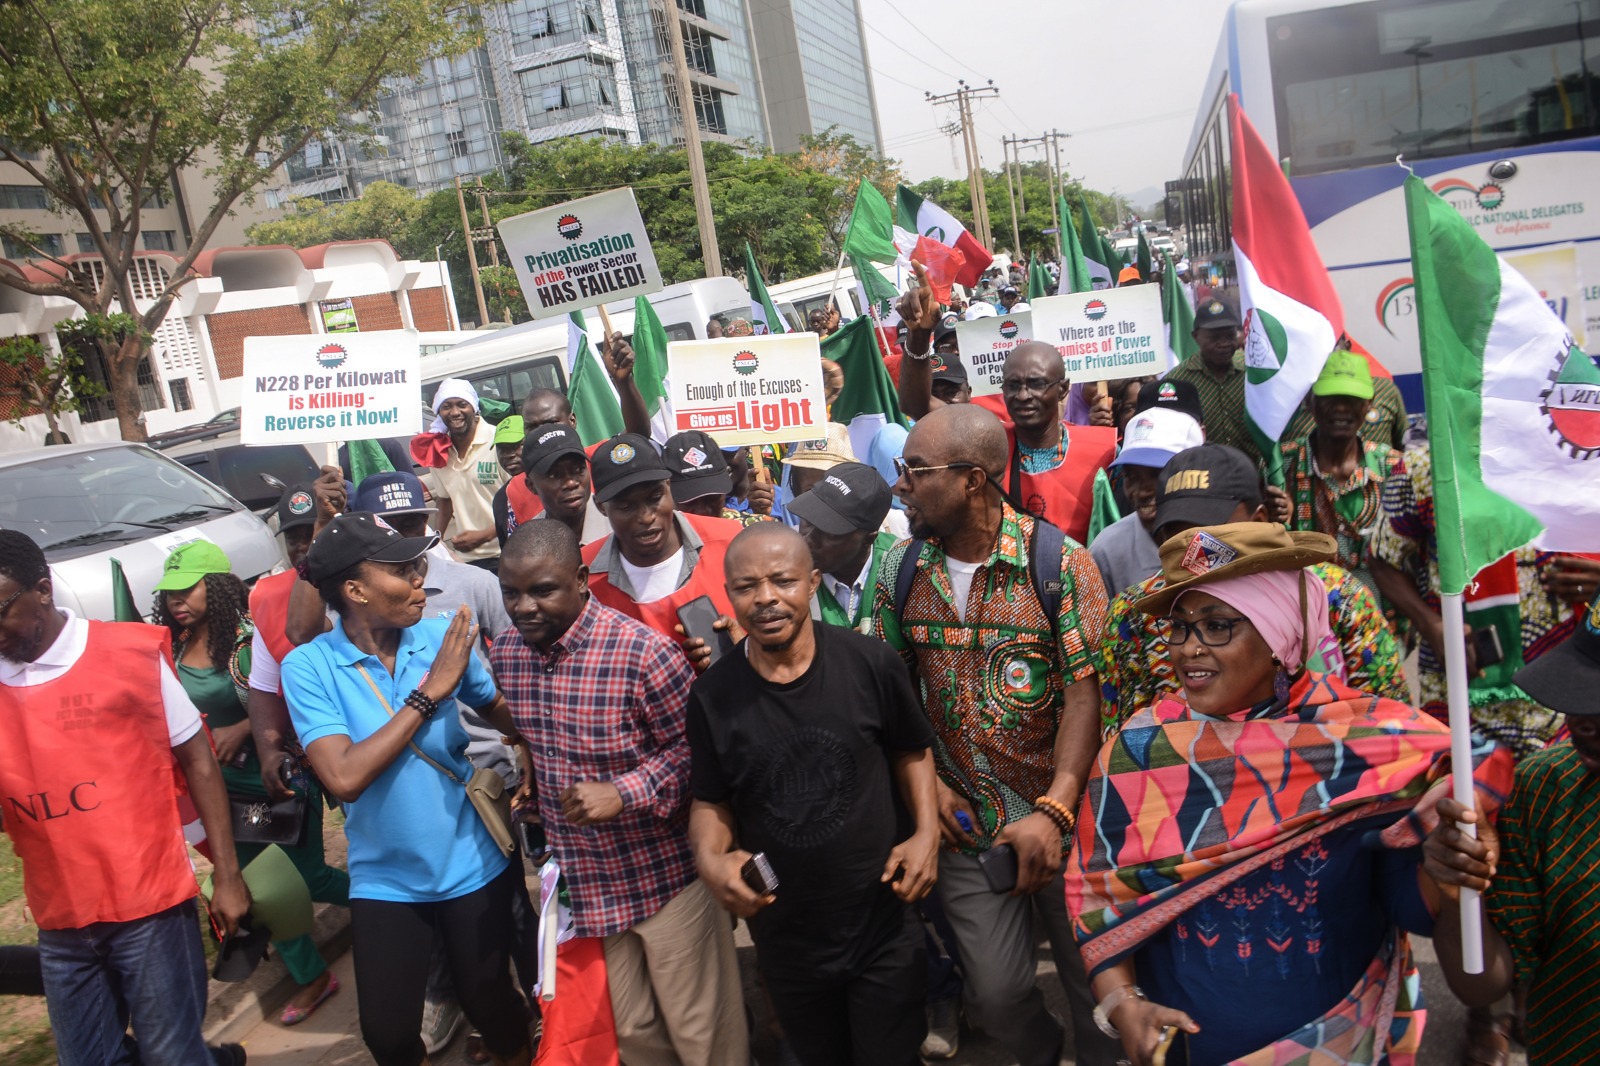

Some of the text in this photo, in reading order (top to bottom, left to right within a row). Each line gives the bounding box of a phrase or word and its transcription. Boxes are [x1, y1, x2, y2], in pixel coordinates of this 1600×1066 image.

[1483, 210, 1529, 224] NATIONAL
[1532, 202, 1584, 219] DELEGATES
[1496, 222, 1551, 235] Conference
[524, 232, 635, 274] Privatisation
[534, 252, 638, 286] of the Power Sector
[536, 264, 647, 308] HAS FAILED!
[1059, 320, 1136, 342] Where are the
[992, 342, 1013, 350] Stop
[1101, 338, 1112, 352] of
[1115, 336, 1151, 350] Power
[977, 364, 987, 376] of
[1085, 350, 1156, 370] Privatisation
[256, 370, 407, 392] N228 Per Kilowatt
[686, 382, 724, 401] Enough
[727, 380, 738, 398] of
[740, 380, 757, 396] the
[760, 378, 802, 394] Excuses
[288, 394, 304, 410] is
[308, 392, 364, 409] Killing
[265, 407, 398, 432] Reverse it Now!
[690, 398, 814, 432] Give us Light
[478, 461, 498, 473] NUT
[379, 493, 392, 502] FCT
[382, 482, 405, 493] NUT
[386, 498, 412, 510] ABUJA
[8, 781, 103, 824] NLC
